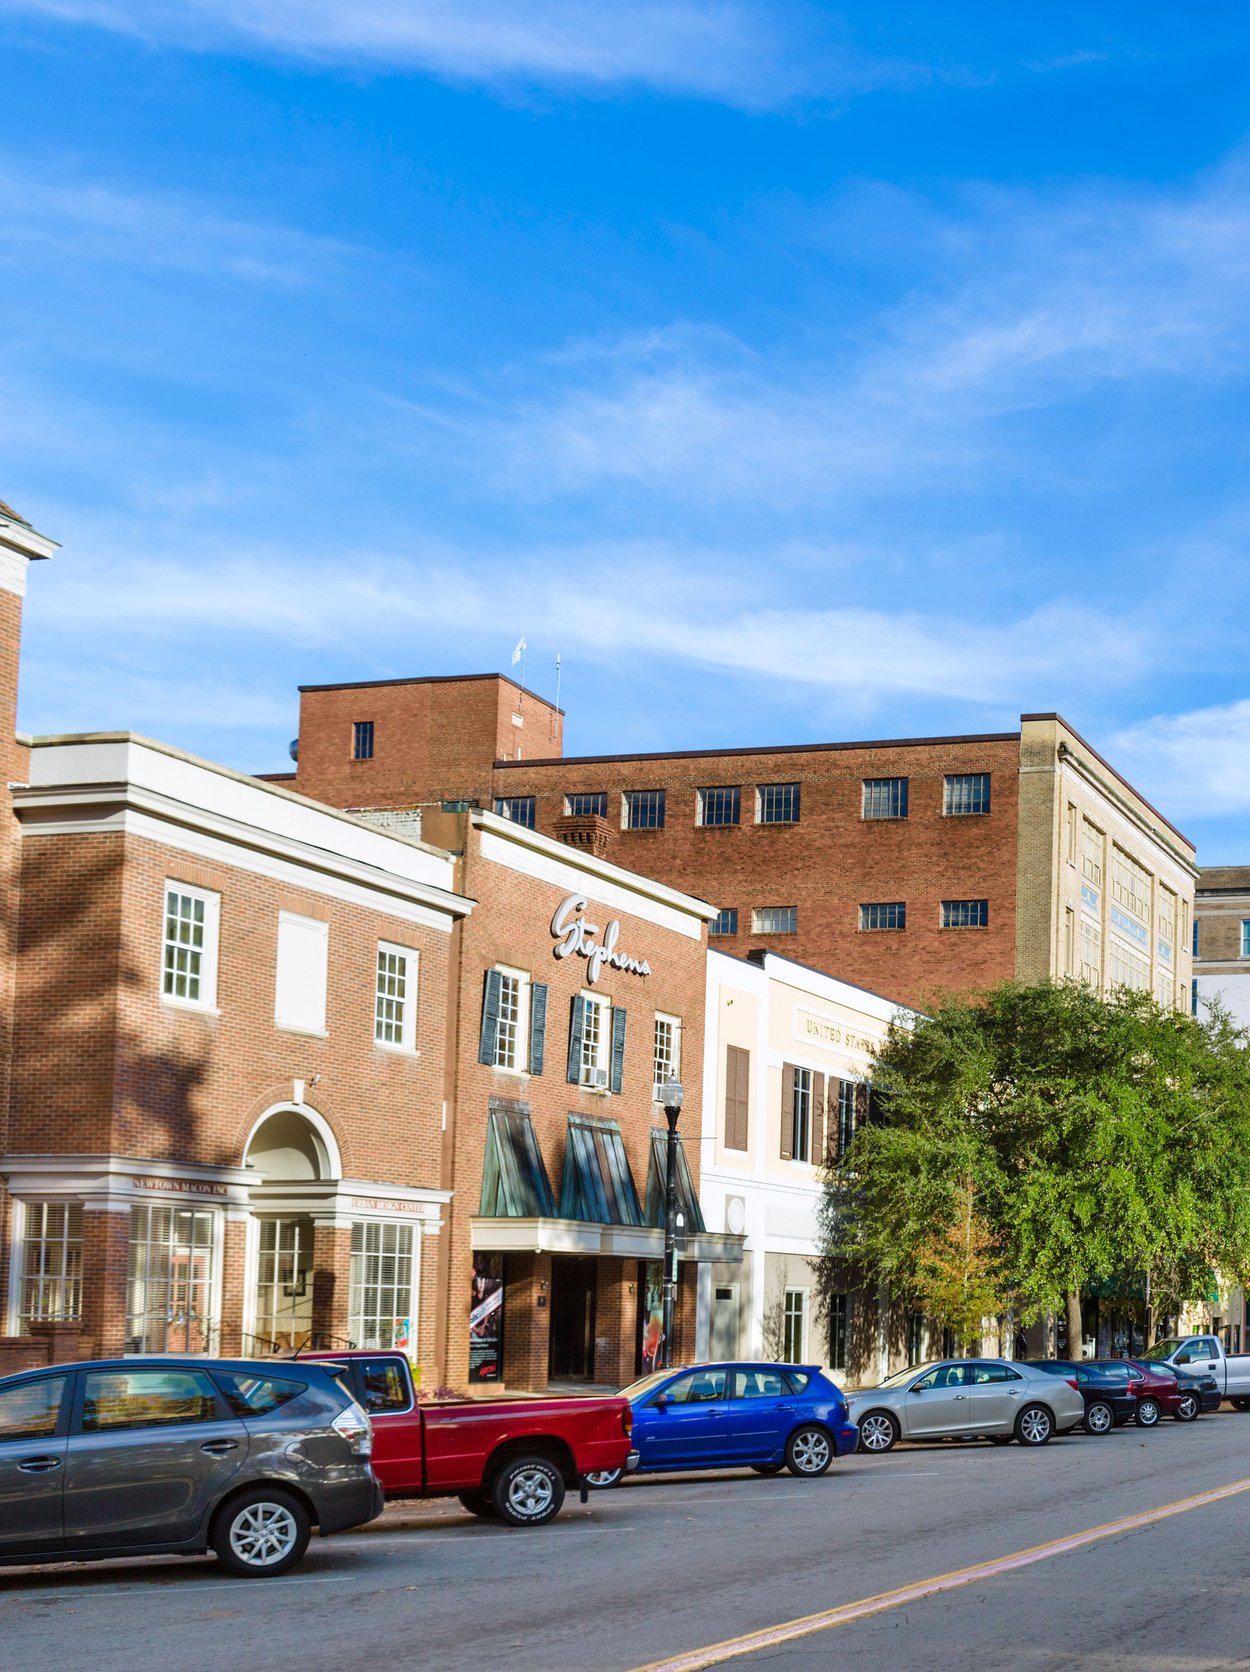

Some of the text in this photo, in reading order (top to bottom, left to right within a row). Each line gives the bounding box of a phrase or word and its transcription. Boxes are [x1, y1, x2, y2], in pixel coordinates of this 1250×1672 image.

[550, 894, 652, 985] Stephens
[806, 1019, 841, 1043] UNITED
[845, 1033, 876, 1055] STATES
[134, 1178, 180, 1192] NEWTOWN
[181, 1183, 212, 1195] MACON
[509, 1464, 556, 1481] PRIMEWELL
